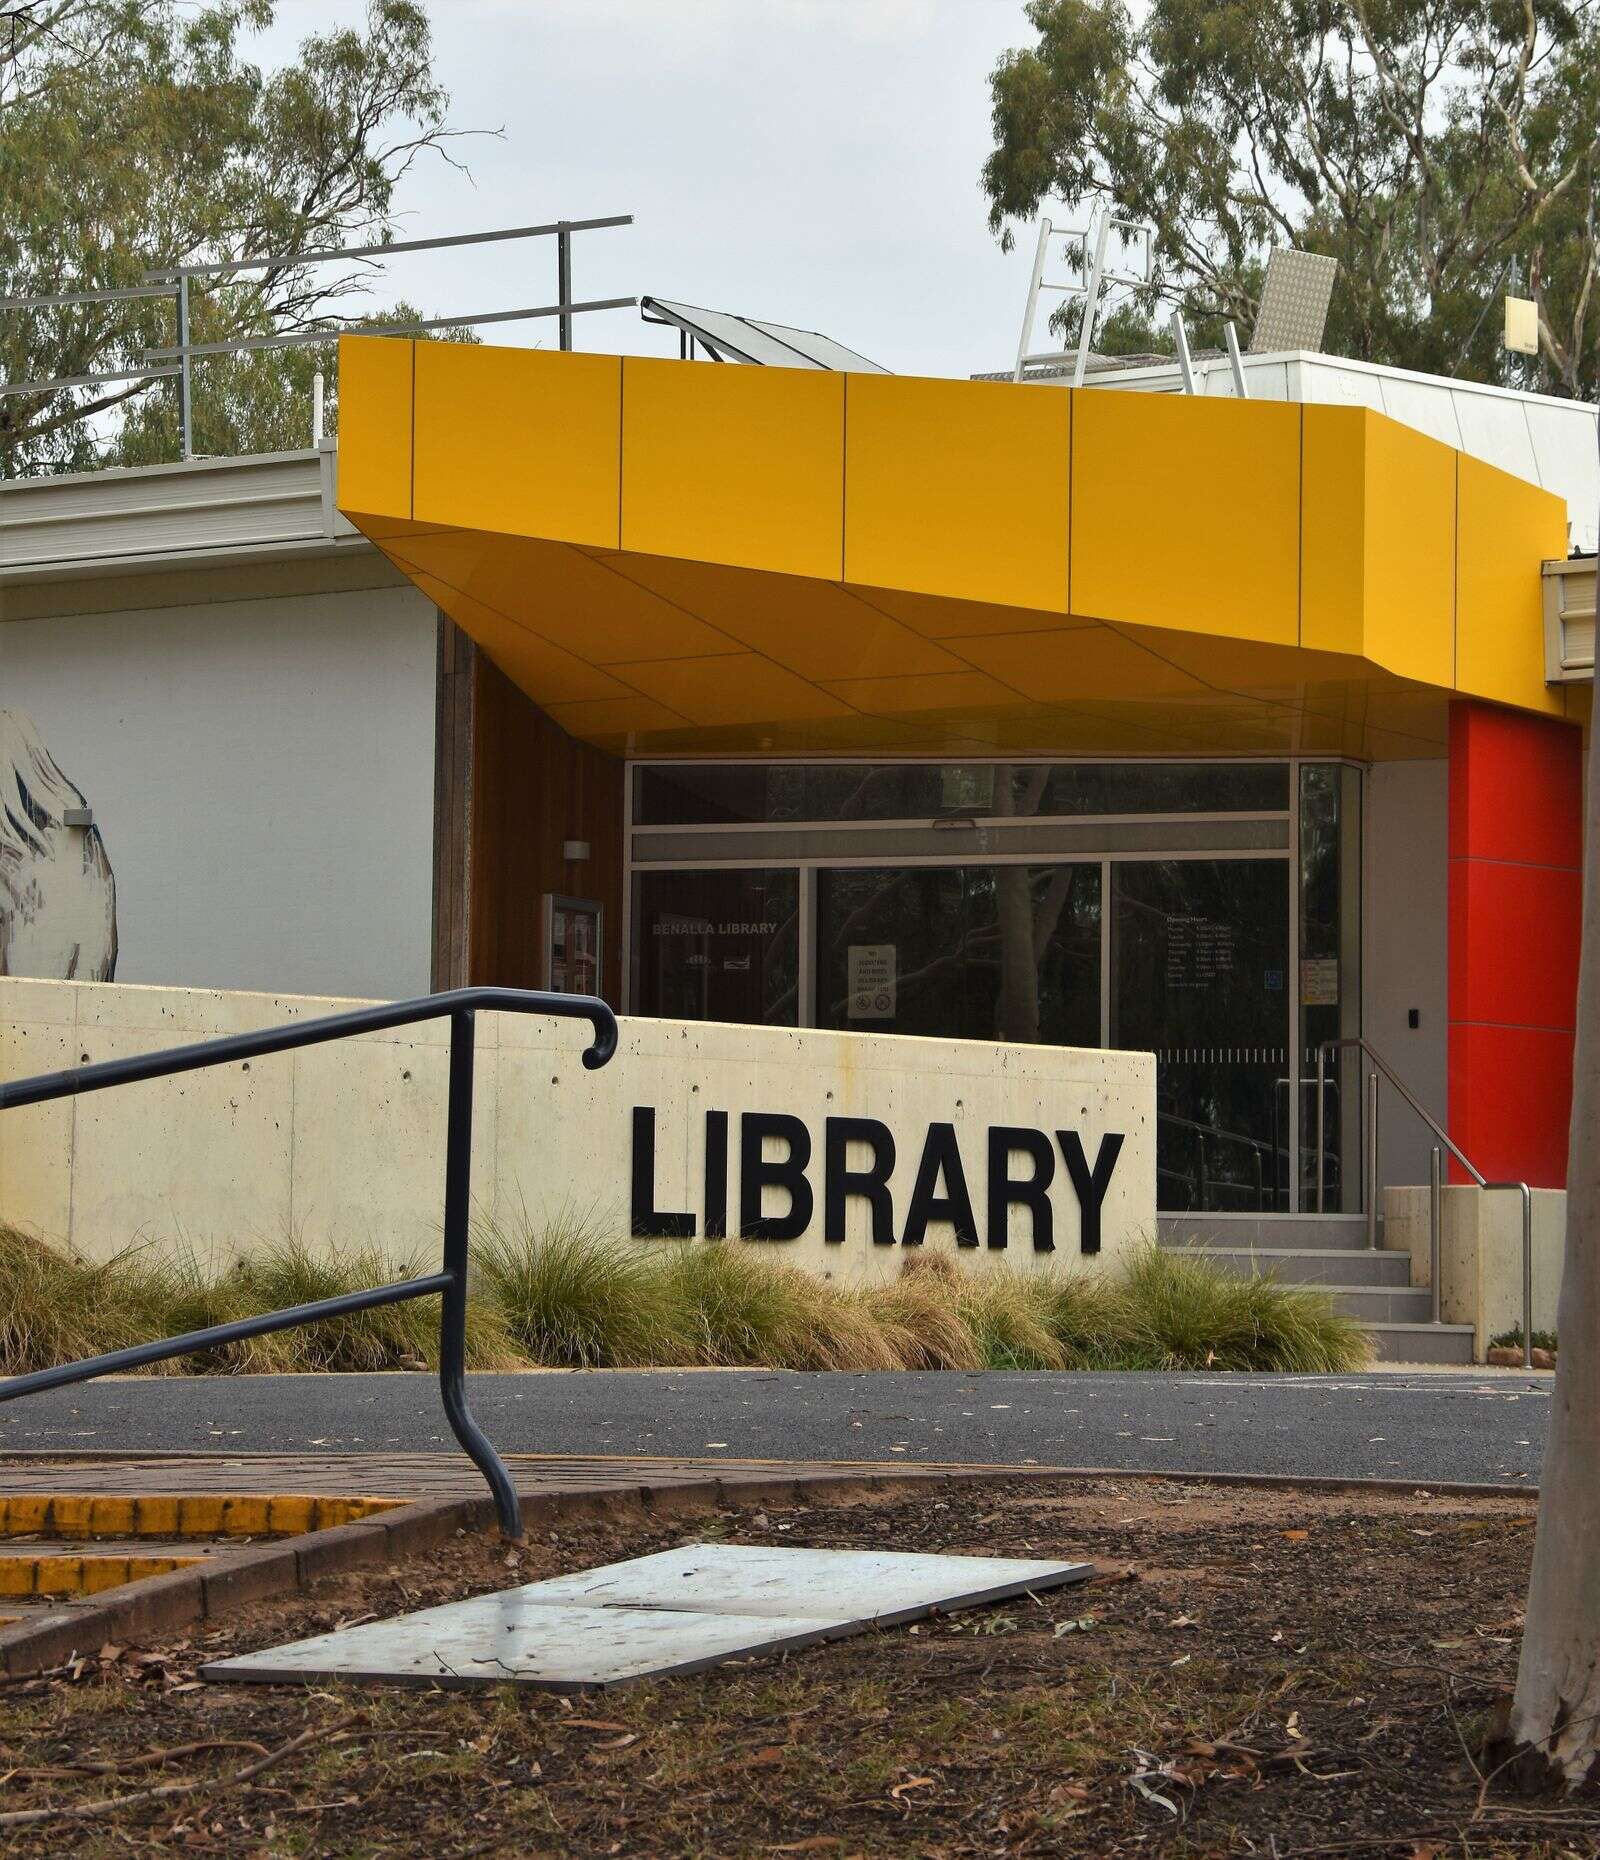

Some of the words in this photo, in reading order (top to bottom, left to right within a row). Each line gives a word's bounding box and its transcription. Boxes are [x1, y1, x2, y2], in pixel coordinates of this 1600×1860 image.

[652, 922, 715, 936] BENALLA
[719, 922, 778, 935] LIBRARY
[631, 1106, 1125, 1254] LIBRARY
